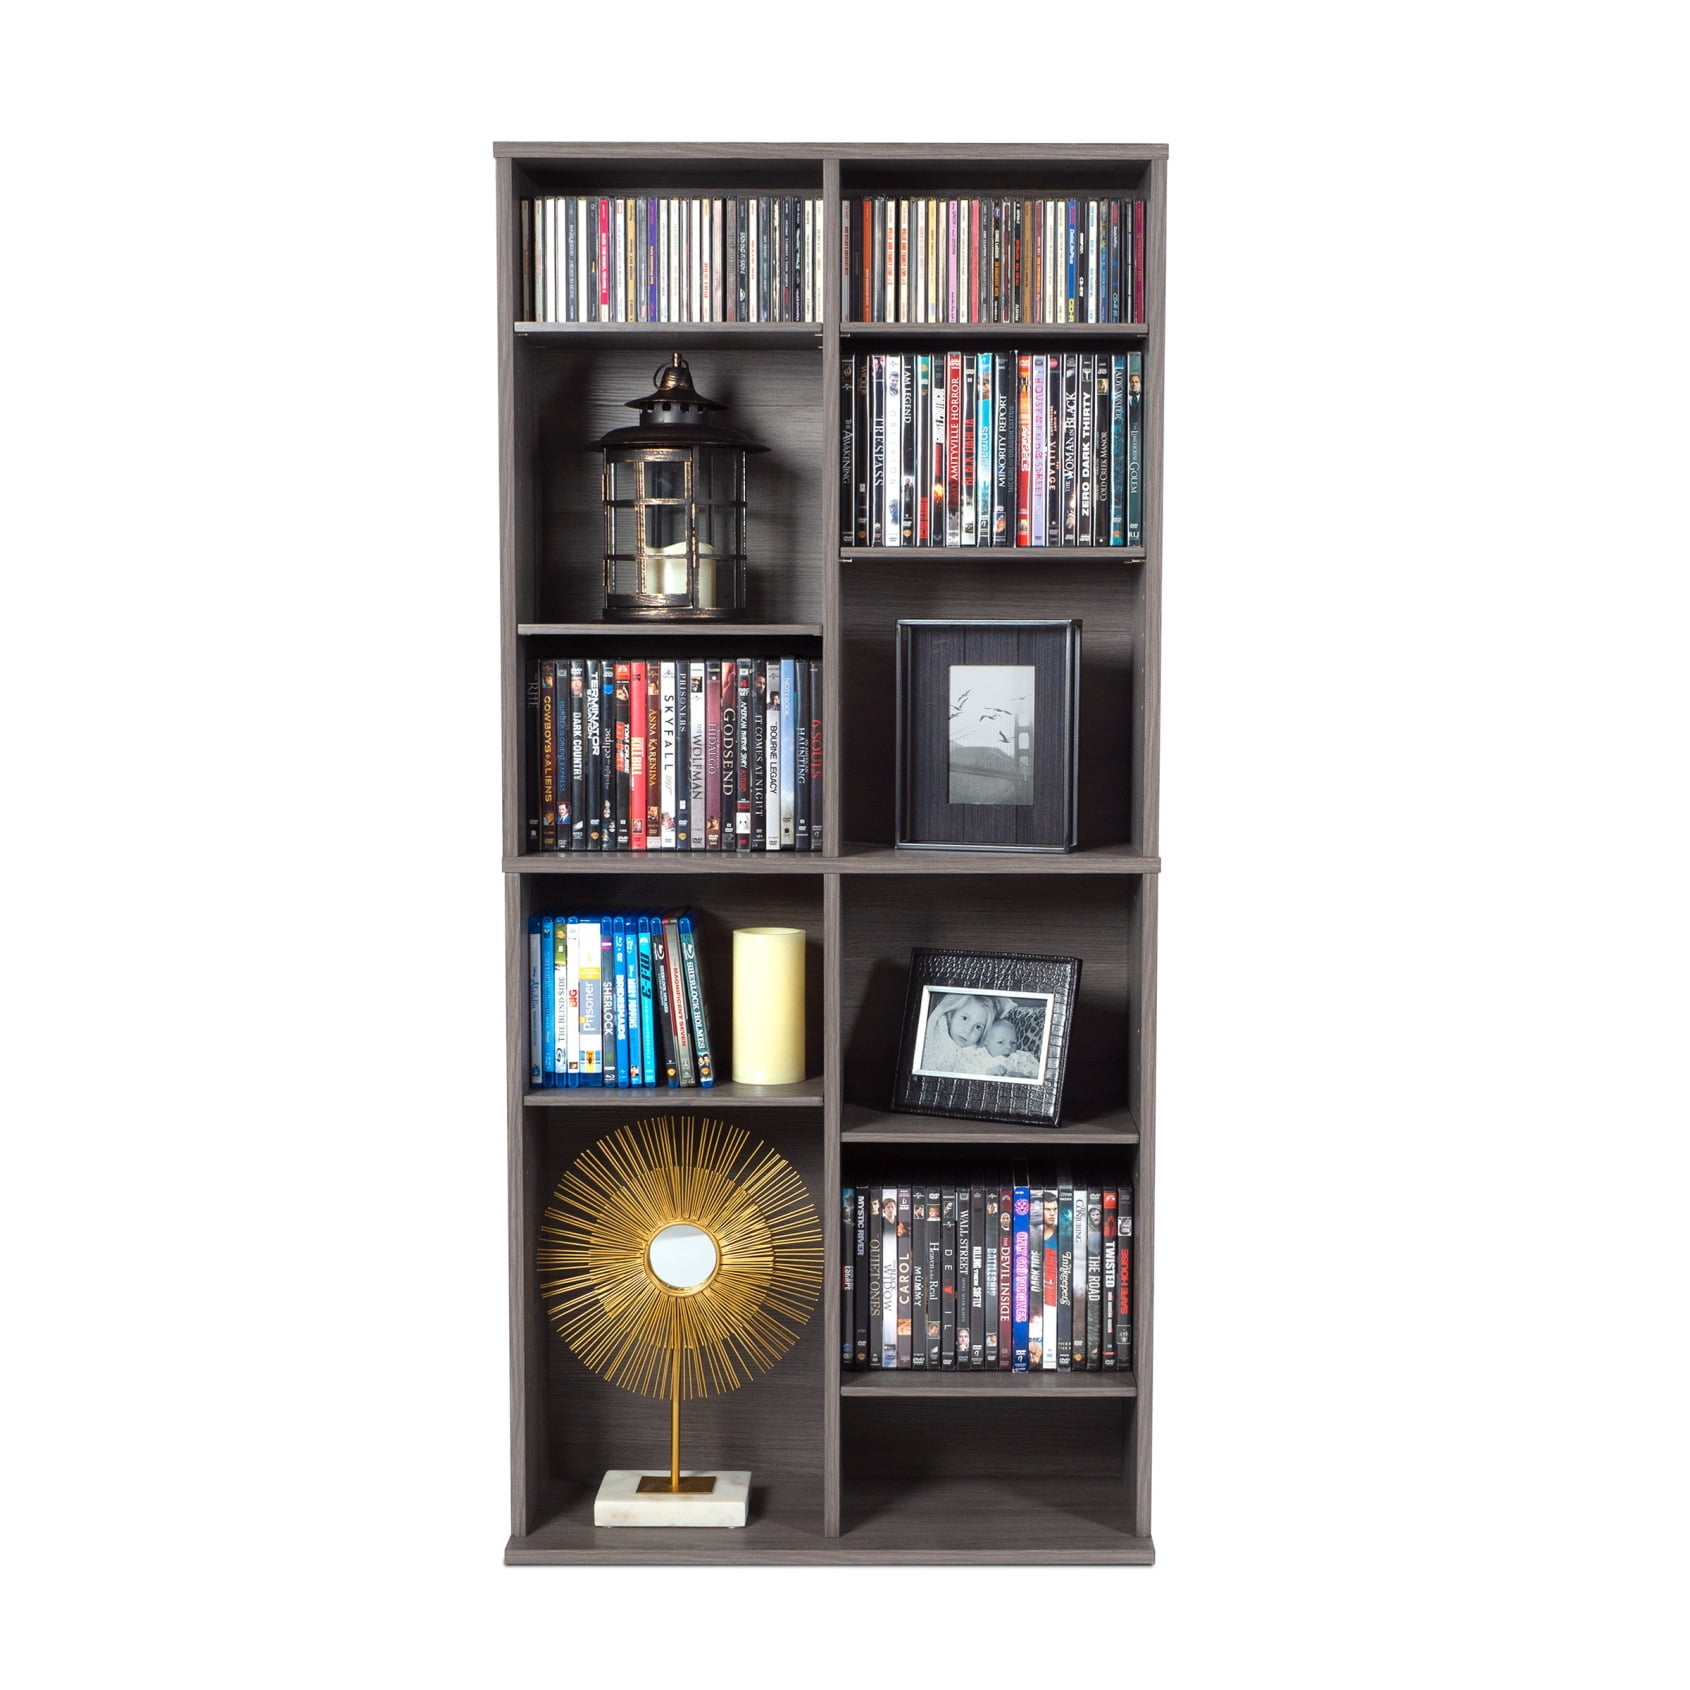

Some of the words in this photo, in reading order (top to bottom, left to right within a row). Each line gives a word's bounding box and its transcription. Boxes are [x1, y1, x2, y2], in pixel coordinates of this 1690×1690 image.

[904, 371, 911, 385] AM
[951, 378, 959, 421] HORROR
[999, 393, 1007, 432] REPORT
[1065, 392, 1076, 428] BLACK
[842, 431, 853, 484] AWAKENING
[874, 416, 883, 486] TRESPASS
[950, 424, 959, 480] AMITYVILLE
[999, 436, 1007, 487] MINORITY
[1064, 437, 1074, 479] WOMAN
[1082, 442, 1090, 477] DARK
[1130, 462, 1140, 493] GOLEM
[1082, 482, 1090, 516] ZERO
[573, 712, 581, 736] DARK
[591, 672, 599, 755] TERMINATOR
[649, 709, 657, 736] ANNA
[755, 715, 762, 725] IT
[811, 720, 821, 728] 6
[601, 728, 614, 758] eclipse
[631, 737, 642, 755] KILL
[663, 695, 674, 771] SKYFALL
[708, 723, 716, 774] HIDALGO
[755, 727, 763, 762] COMES
[574, 739, 582, 781] COUNTRY
[631, 757, 642, 775] BILL
[648, 738, 658, 786] KARENINA
[692, 734, 702, 800] WOLFMAN
[723, 708, 735, 795] GODSEND
[797, 728, 805, 784] HAUNTING
[810, 732, 822, 778] SOULS
[544, 759, 552, 802] ALIENS
[755, 766, 763, 776] AT
[755, 780, 763, 816] NIGHT
[569, 989, 577, 1007] BIG
[583, 981, 596, 1031] Prisoner
[627, 978, 636, 998] MARY
[673, 967, 682, 1020] MAGNIFICENT
[686, 962, 699, 1010] SHERLOCK
[694, 1012, 706, 1049] HOLMES
[604, 982, 613, 1035] SHERLOCK
[616, 975, 625, 1040] BRIDESMAIDS
[628, 1000, 637, 1028] POPPINS
[960, 1210, 968, 1237] WALL
[1075, 1199, 1083, 1243] CONJURING
[870, 1239, 880, 1279] QUIET
[929, 1242, 939, 1269] Heaven
[960, 1239, 968, 1275] STREET
[973, 1246, 981, 1268] KILLING
[1017, 1232, 1027, 1254] ONLY
[1031, 1250, 1041, 1267] TIDE
[845, 1266, 853, 1290] ESCAPE
[900, 1254, 909, 1304] CAROL
[987, 1248, 997, 1296] BATTLESHIP
[1001, 1246, 1010, 1279] DEVIL
[1017, 1257, 1027, 1275] GOD
[1031, 1269, 1041, 1292] DARK
[1060, 1252, 1072, 1306] Innkeepers
[1089, 1256, 1100, 1273] THE
[1105, 1241, 1115, 1287] TWISTED
[1120, 1248, 1129, 1286] HOUSE
[871, 1281, 880, 1316] ONES
[884, 1264, 892, 1312] WIDOW
[914, 1266, 923, 1307] MUMMY
[929, 1281, 938, 1300] Real
[973, 1286, 981, 1308] SOFTLY
[1001, 1282, 1010, 1321] INSIDE
[1017, 1276, 1027, 1322] FORGIVES
[1089, 1276, 1100, 1301] ROAD
[1120, 1287, 1129, 1315] SAFE
